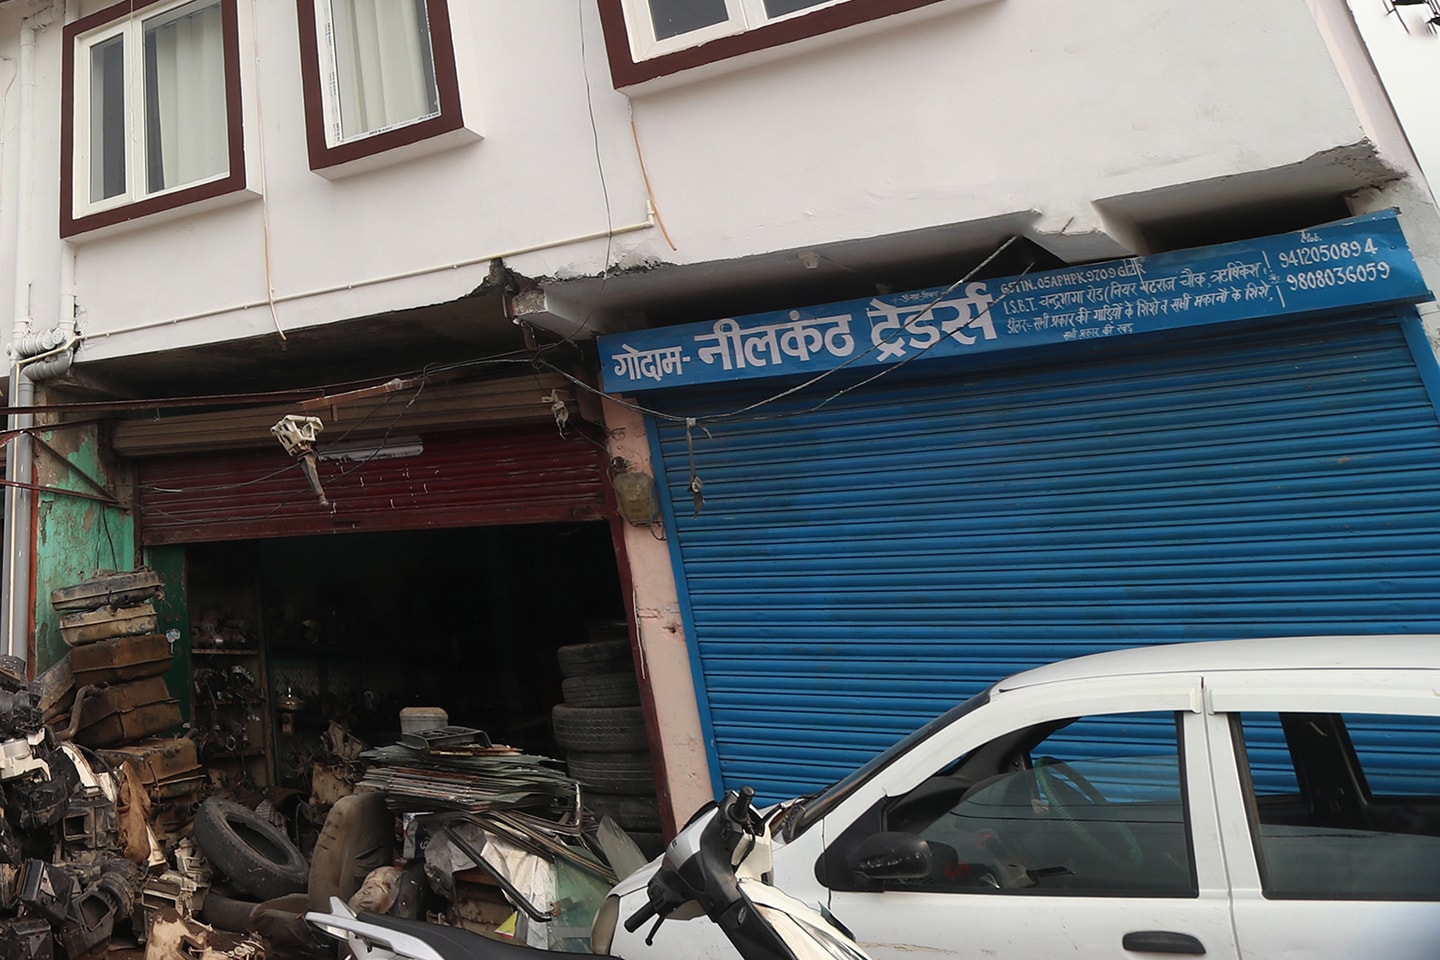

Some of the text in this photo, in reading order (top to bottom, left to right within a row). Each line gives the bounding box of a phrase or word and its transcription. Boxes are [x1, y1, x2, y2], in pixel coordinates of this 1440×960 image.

[1278, 237, 1379, 269] 9412050894
[1286, 261, 1391, 292] 9808036059
[693, 310, 855, 372] नीलकंठ
[865, 281, 997, 362] ट्रेडर्स
